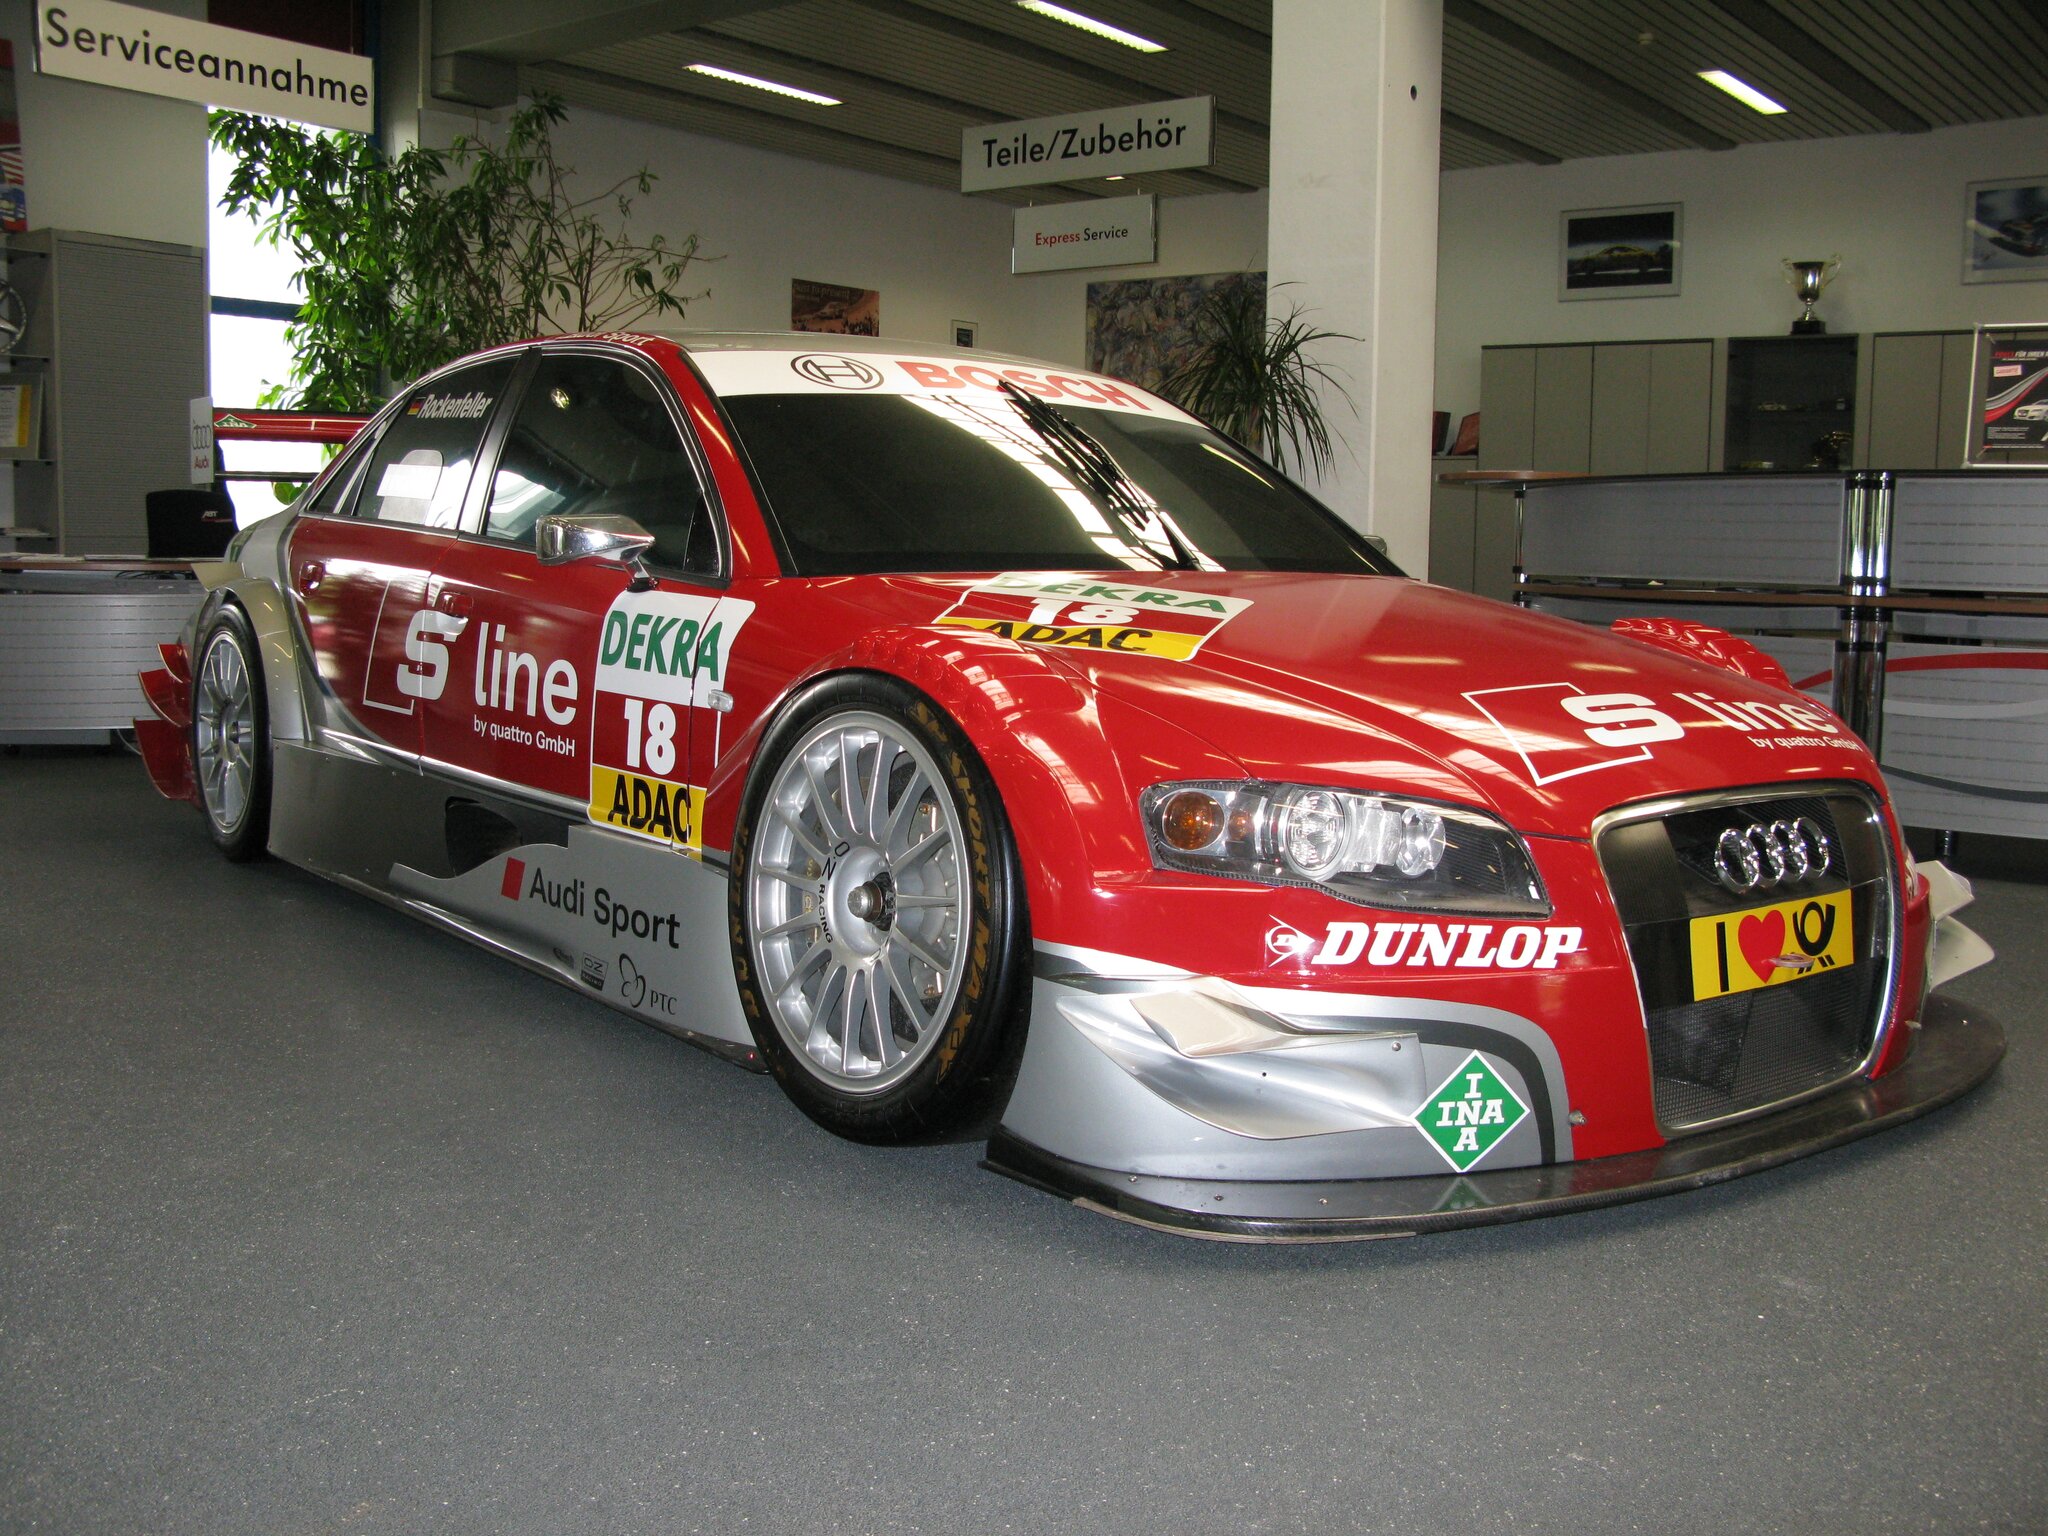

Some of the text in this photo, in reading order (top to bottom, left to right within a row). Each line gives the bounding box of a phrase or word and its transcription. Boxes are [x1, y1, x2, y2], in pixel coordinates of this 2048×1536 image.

[46, 8, 369, 107] Serviceannahme
[983, 118, 1187, 168] Teile/Zubehör
[1035, 226, 1129, 248] Express Service
[417, 391, 493, 419] Rockenfeller
[895, 361, 1152, 411] BOSCH
[989, 575, 1228, 614] DEKRA
[1027, 597, 1140, 625] 18
[600, 610, 724, 682] DEKRA
[982, 620, 1153, 651] ADAC
[396, 609, 578, 726] S line
[473, 714, 576, 758] by quattro GmbH
[623, 698, 677, 776] 18
[1560, 692, 1840, 747] S line
[1748, 735, 1774, 750] by
[1775, 736, 1824, 749] quattro
[607, 773, 693, 844] ADAC
[529, 867, 681, 949] Audi Sport
[818, 883, 834, 943] RACING
[1311, 921, 1584, 969] DUNLOP
[1715, 921, 1730, 993] I
[650, 989, 678, 1016] PTC
[1436, 1099, 1505, 1127] INA
